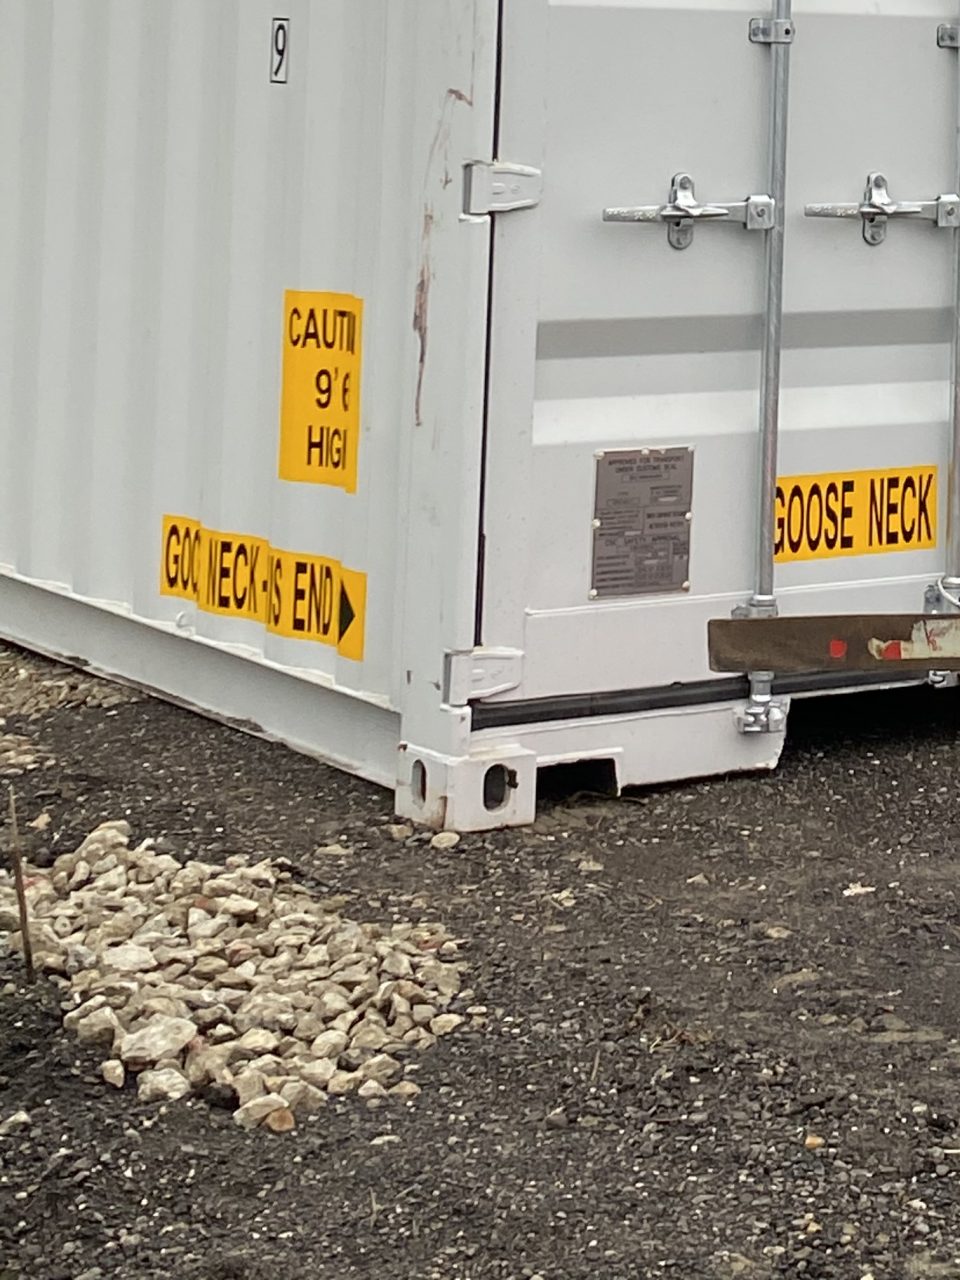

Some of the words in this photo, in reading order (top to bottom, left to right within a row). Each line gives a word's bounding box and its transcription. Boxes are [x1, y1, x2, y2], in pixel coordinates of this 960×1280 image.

[272, 22, 288, 78] 9
[774, 480, 854, 556] GOOSE
[868, 474, 933, 547] NECK
[206, 537, 260, 614] NECK
[292, 561, 333, 636] END
